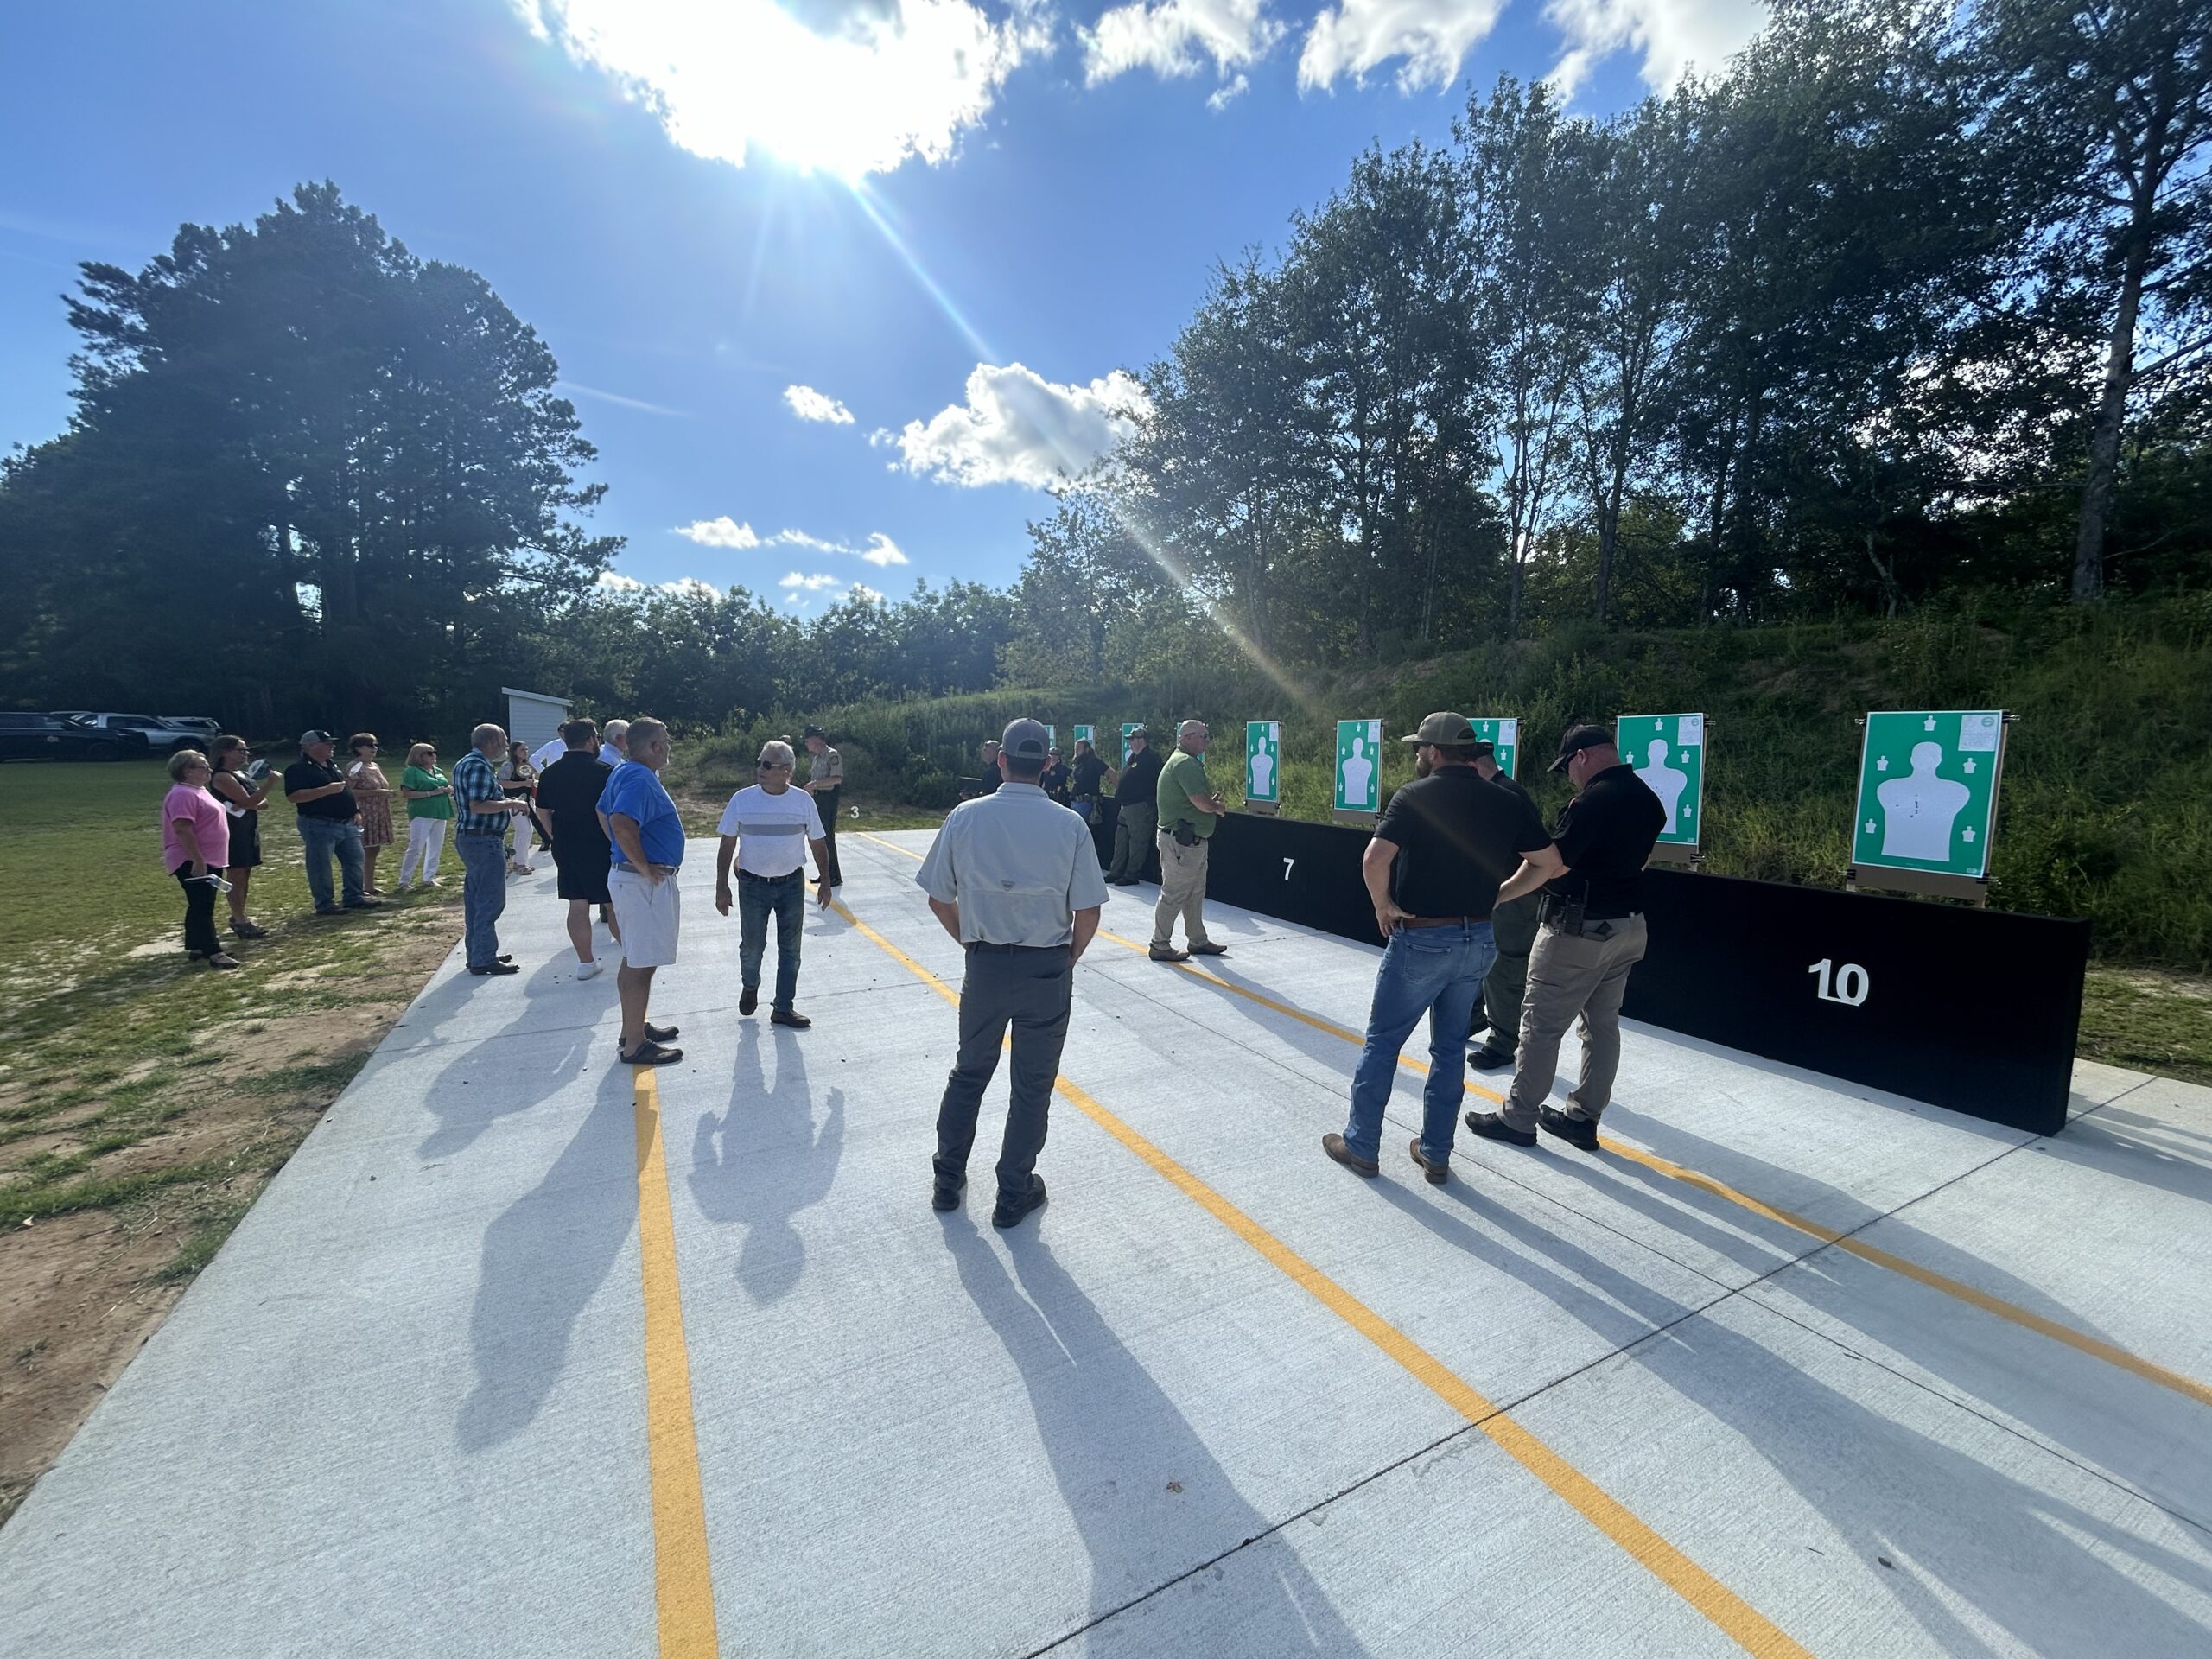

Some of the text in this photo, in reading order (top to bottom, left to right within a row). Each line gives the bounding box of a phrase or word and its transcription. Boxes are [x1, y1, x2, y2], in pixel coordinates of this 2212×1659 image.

[850, 805, 860, 818] 3
[1283, 857, 1294, 880] 7
[1808, 958, 1869, 1007] 10
